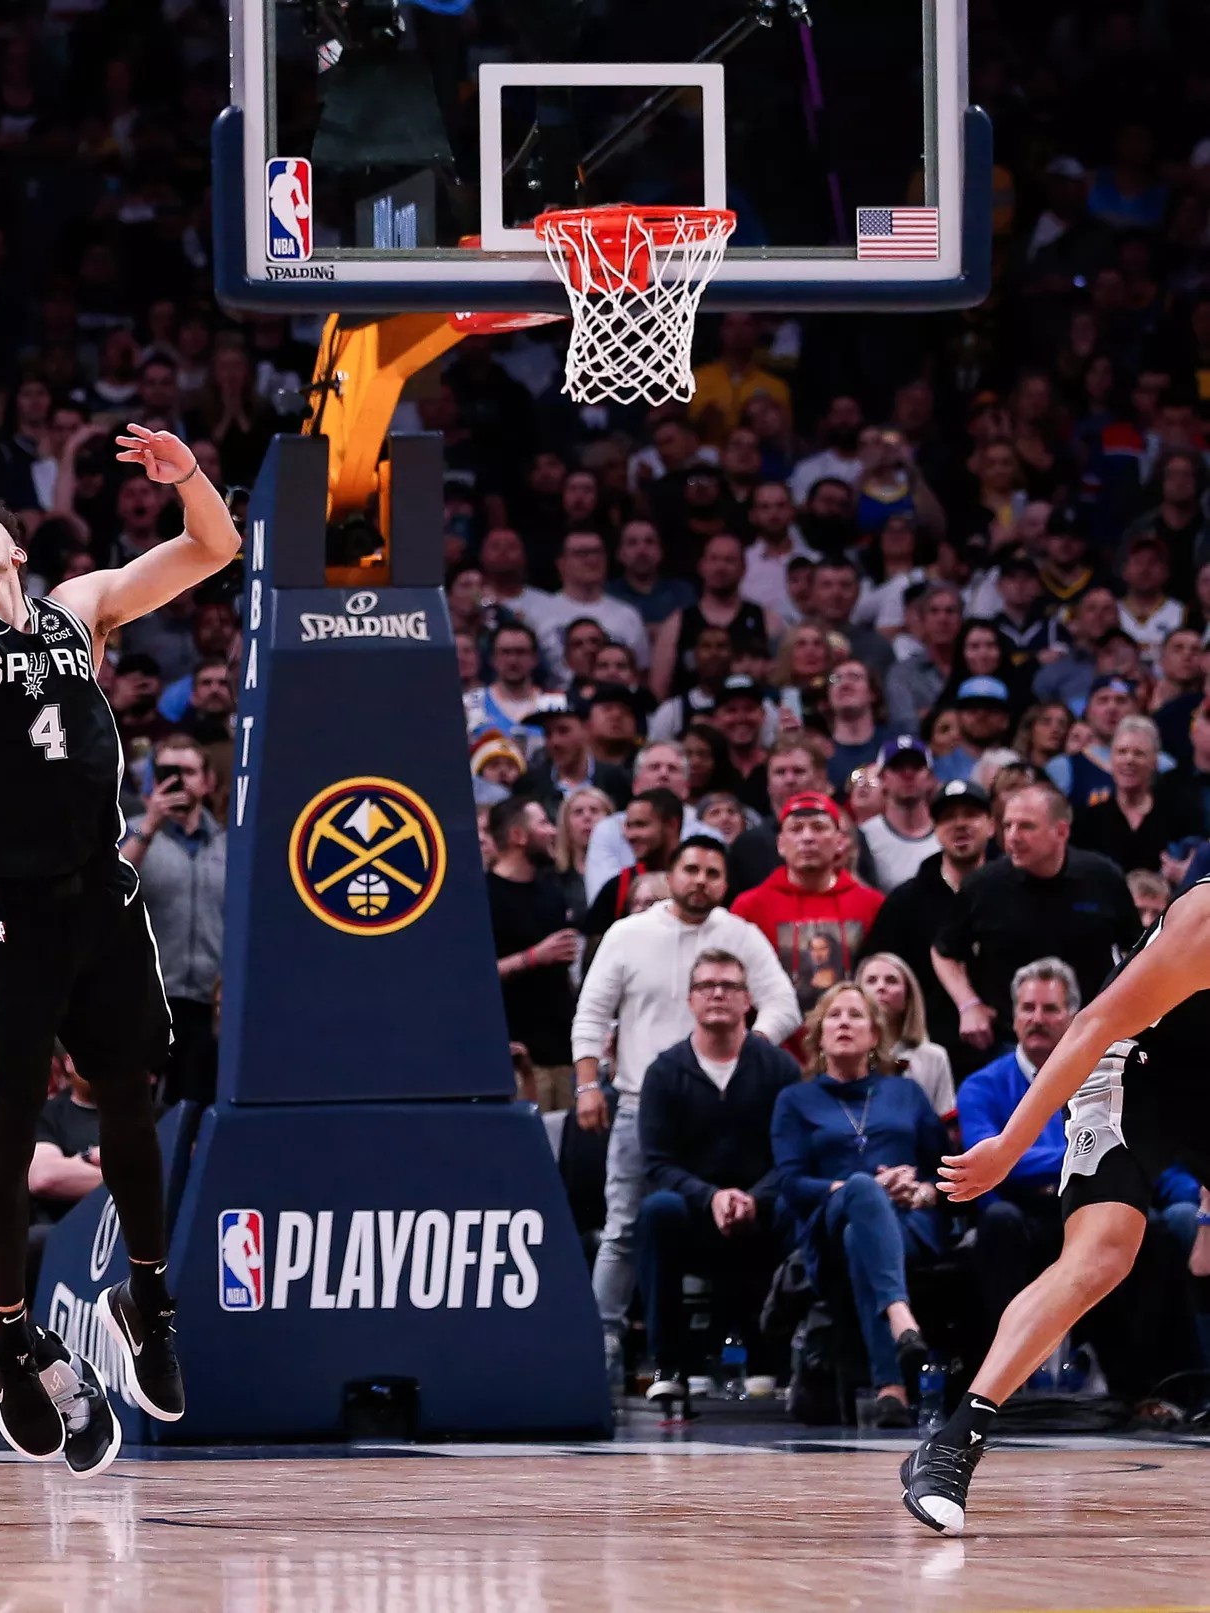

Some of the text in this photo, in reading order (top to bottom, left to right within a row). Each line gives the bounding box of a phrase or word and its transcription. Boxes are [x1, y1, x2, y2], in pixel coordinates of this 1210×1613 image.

[273, 237, 296, 255] NBA
[265, 264, 335, 281] SPALDING
[245, 519, 265, 690] NBA
[41, 626, 74, 645] Frost
[299, 610, 431, 642] SPALDING
[28, 703, 69, 761] 4
[271, 1209, 544, 1310] PLAYOFFS
